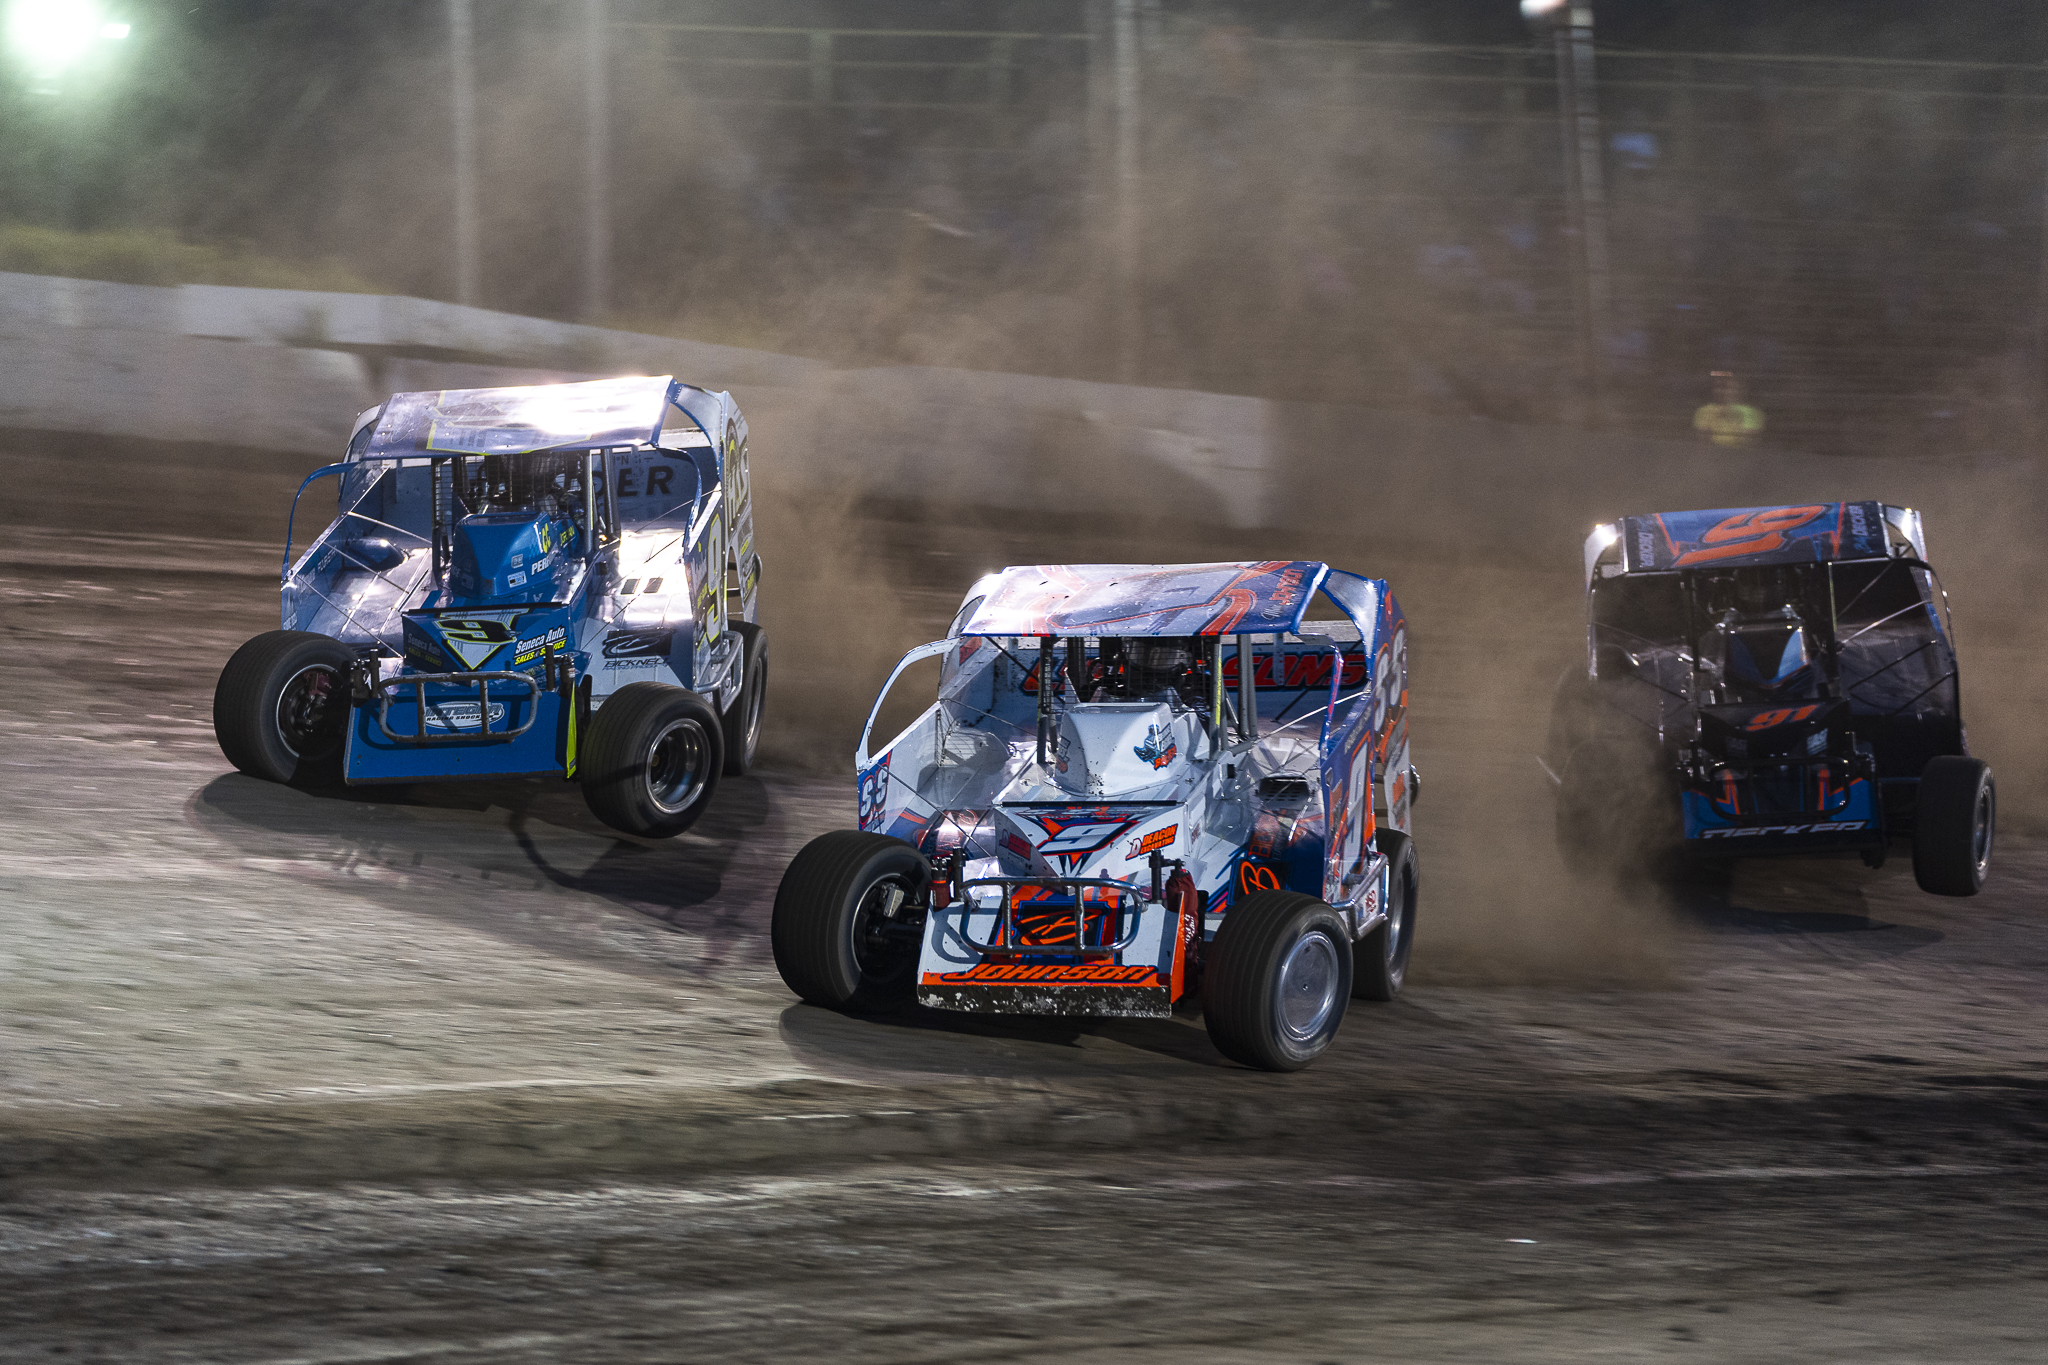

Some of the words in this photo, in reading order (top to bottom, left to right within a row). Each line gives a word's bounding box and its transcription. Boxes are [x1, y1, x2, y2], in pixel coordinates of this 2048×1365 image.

[515, 634, 545, 655] Seneca
[545, 627, 566, 643] Auto
[514, 651, 535, 665] SALES
[1746, 704, 1819, 731] 91
[1037, 821, 1127, 852] 9
[1142, 824, 1178, 845] DEACON
[943, 964, 1156, 980] JOHNSON
